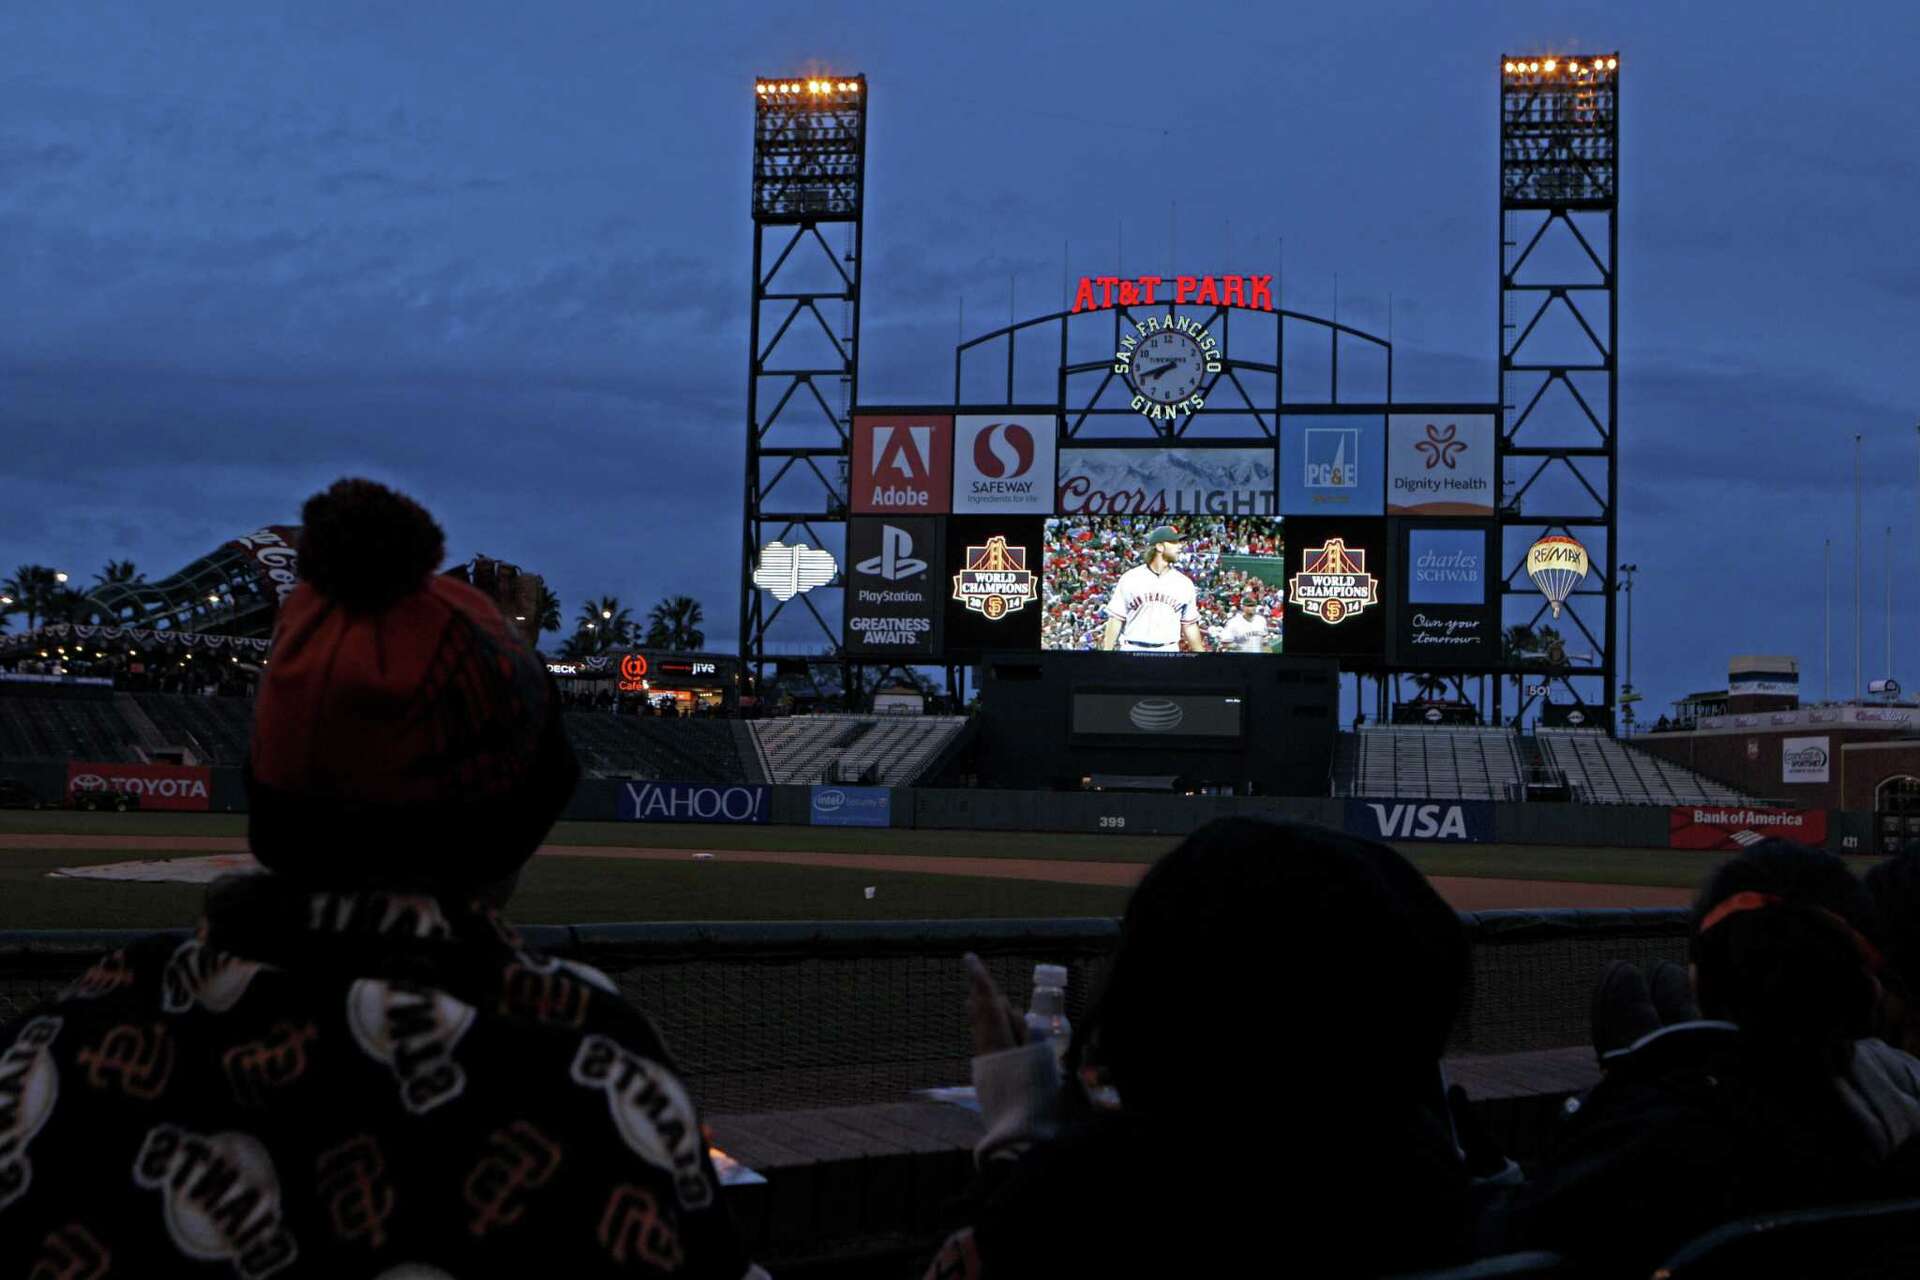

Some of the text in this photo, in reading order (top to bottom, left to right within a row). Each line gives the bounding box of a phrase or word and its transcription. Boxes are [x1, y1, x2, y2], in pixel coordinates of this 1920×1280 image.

[1072, 274, 1273, 313] AT&T PARK
[1115, 314, 1221, 374] SAN FRANCISCO
[1130, 393, 1204, 420] GIANTS
[1308, 464, 1354, 485] PG&E
[972, 481, 1033, 494] SAFEWAY
[1394, 477, 1487, 492] Dignity Health
[872, 486, 928, 506] Adobe
[1056, 476, 1275, 515] Coors LIGHT
[1417, 549, 1477, 568] charles
[1534, 547, 1581, 564] RE/MAX
[975, 573, 1016, 583] WORLD
[1312, 576, 1355, 586] WORLD
[1417, 569, 1478, 582] SCHWAB
[962, 583, 1029, 594] CHAMPIONS
[1299, 586, 1368, 597] CHAMPIONS
[859, 590, 922, 604] PlayStation
[1009, 598, 1020, 608] 14
[1307, 601, 1318, 611] 20
[1348, 601, 1359, 612] 14
[850, 618, 930, 631] GREATNESS
[1412, 613, 1480, 635] Own your
[863, 631, 916, 644] AWAITS
[1412, 631, 1480, 644] tomorrow
[547, 664, 576, 674] DECK
[1529, 686, 1550, 696] 501
[110, 777, 208, 798] TOYOTA
[626, 783, 762, 821] YAHOO!
[1100, 816, 1125, 828] 399
[1366, 803, 1467, 839] VISA
[1694, 811, 1802, 826] Bank of America
